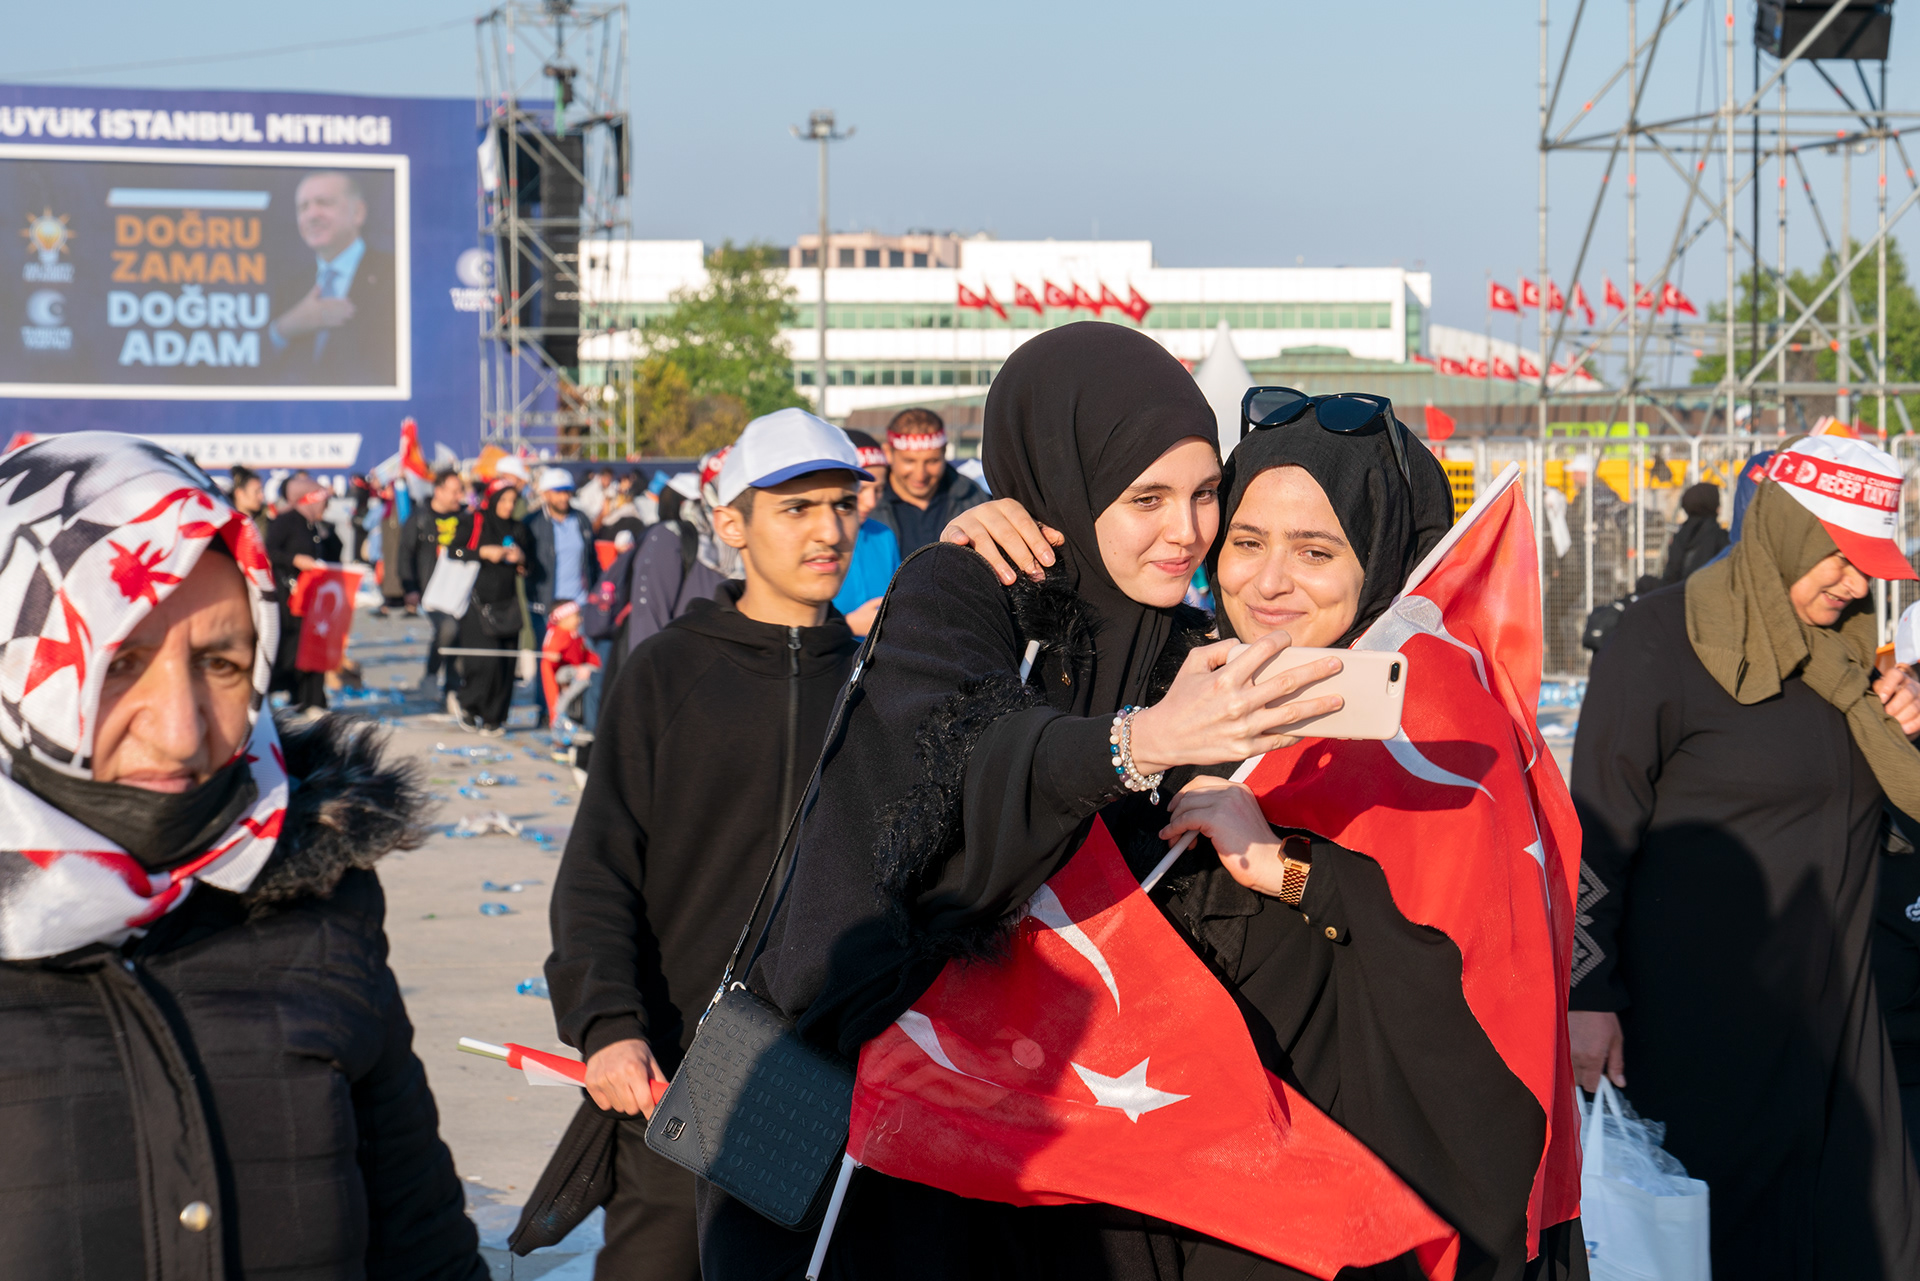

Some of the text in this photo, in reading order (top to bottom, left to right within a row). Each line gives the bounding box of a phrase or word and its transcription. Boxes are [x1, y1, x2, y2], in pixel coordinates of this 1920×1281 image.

[0, 106, 97, 138] ÜYÜK
[115, 209, 261, 249] DOĞRU
[110, 250, 267, 285] ZAMAN
[107, 283, 270, 329] DOĞRU
[118, 329, 261, 368] ADAM
[1815, 472, 1862, 499] RECEP
[772, 1050, 824, 1083] JUST
[750, 1089, 801, 1122] JUST
[792, 1087, 841, 1119] JUST
[772, 1127, 823, 1160] JUST
[752, 1167, 801, 1199] JUST
